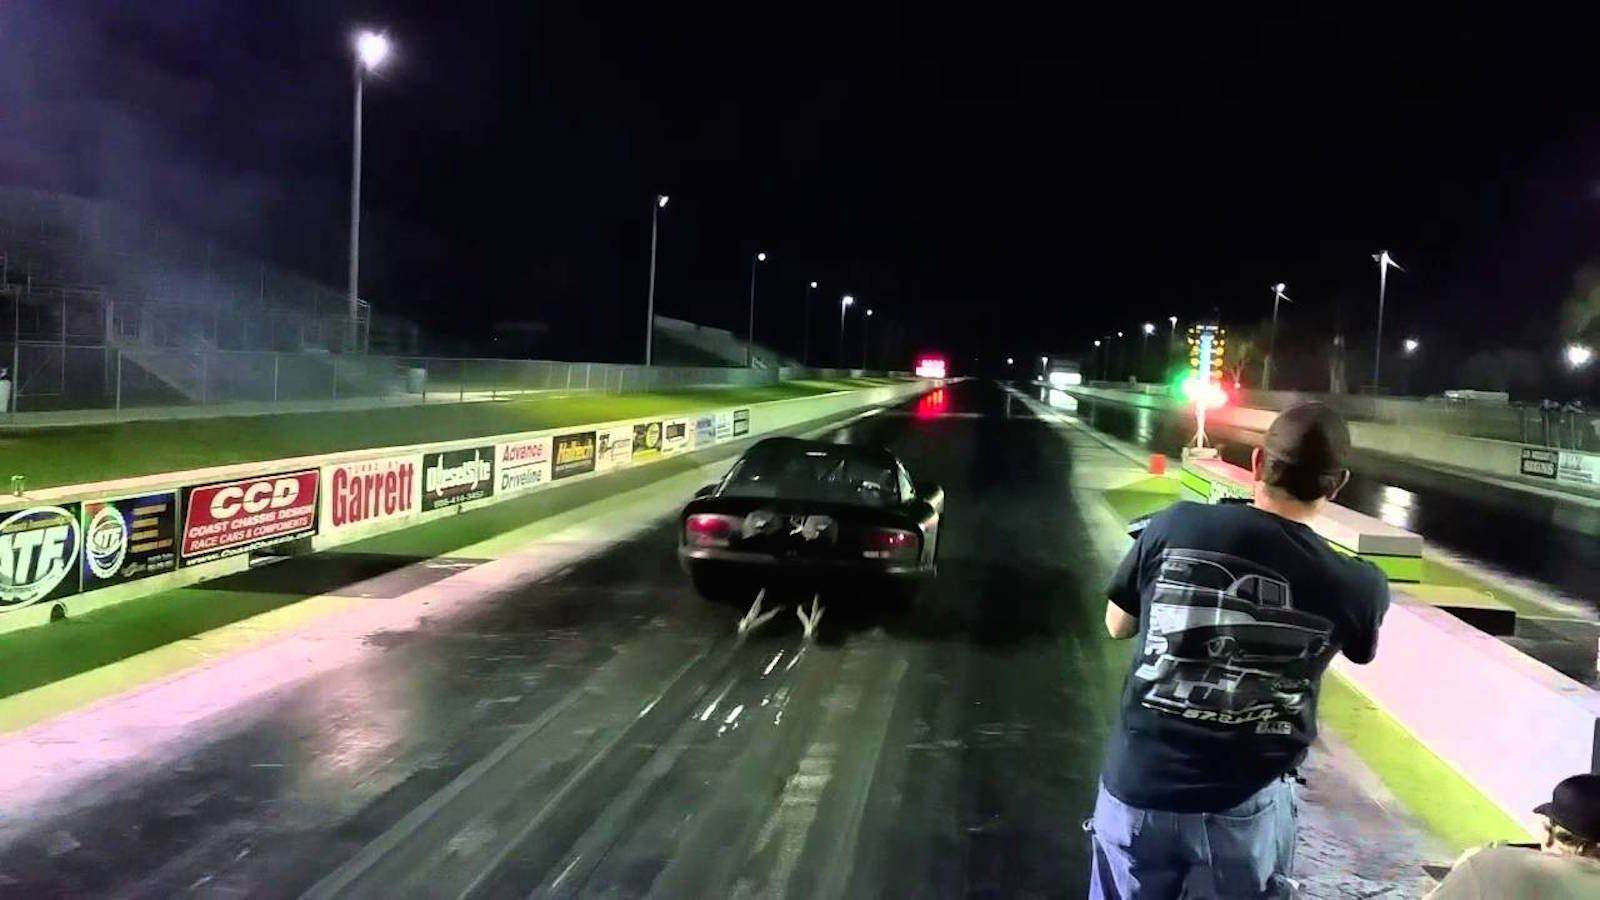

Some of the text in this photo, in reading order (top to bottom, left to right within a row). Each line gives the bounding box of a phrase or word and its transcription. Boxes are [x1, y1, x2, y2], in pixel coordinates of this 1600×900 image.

[502, 442, 543, 463] Advance
[501, 468, 542, 490] Driveline
[209, 478, 300, 519] CCD
[332, 463, 413, 527] Garrett
[189, 520, 229, 538] COAST
[230, 511, 276, 530] CHASSIS
[190, 535, 218, 551] RACE
[219, 529, 245, 545] CARS
[253, 515, 308, 537] COMPONENTS
